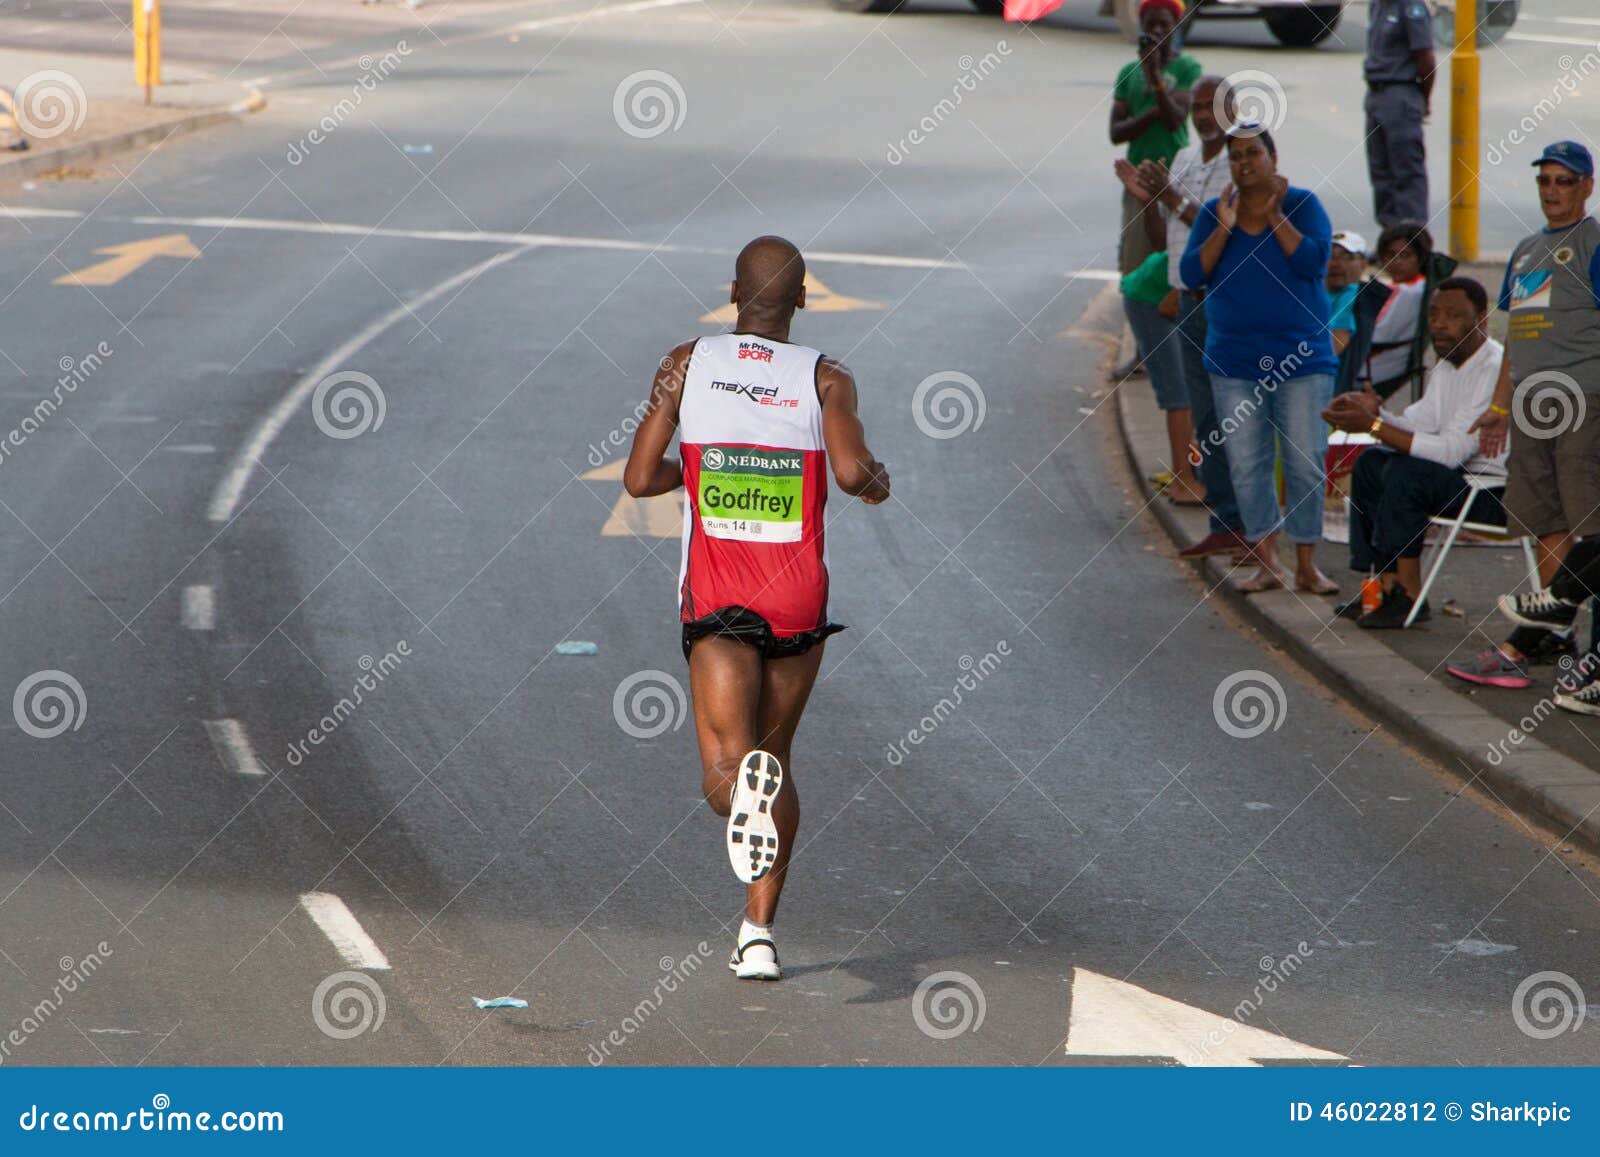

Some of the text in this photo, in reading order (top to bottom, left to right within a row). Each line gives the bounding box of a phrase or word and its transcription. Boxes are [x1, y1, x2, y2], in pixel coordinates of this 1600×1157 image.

[739, 342, 775, 354] Mr Price
[738, 349, 774, 363] SPORT
[759, 397, 799, 408] ELITE
[728, 455, 801, 470] NEDBANK
[703, 485, 794, 518] Godfrey
[707, 521, 746, 531] Runs 14
